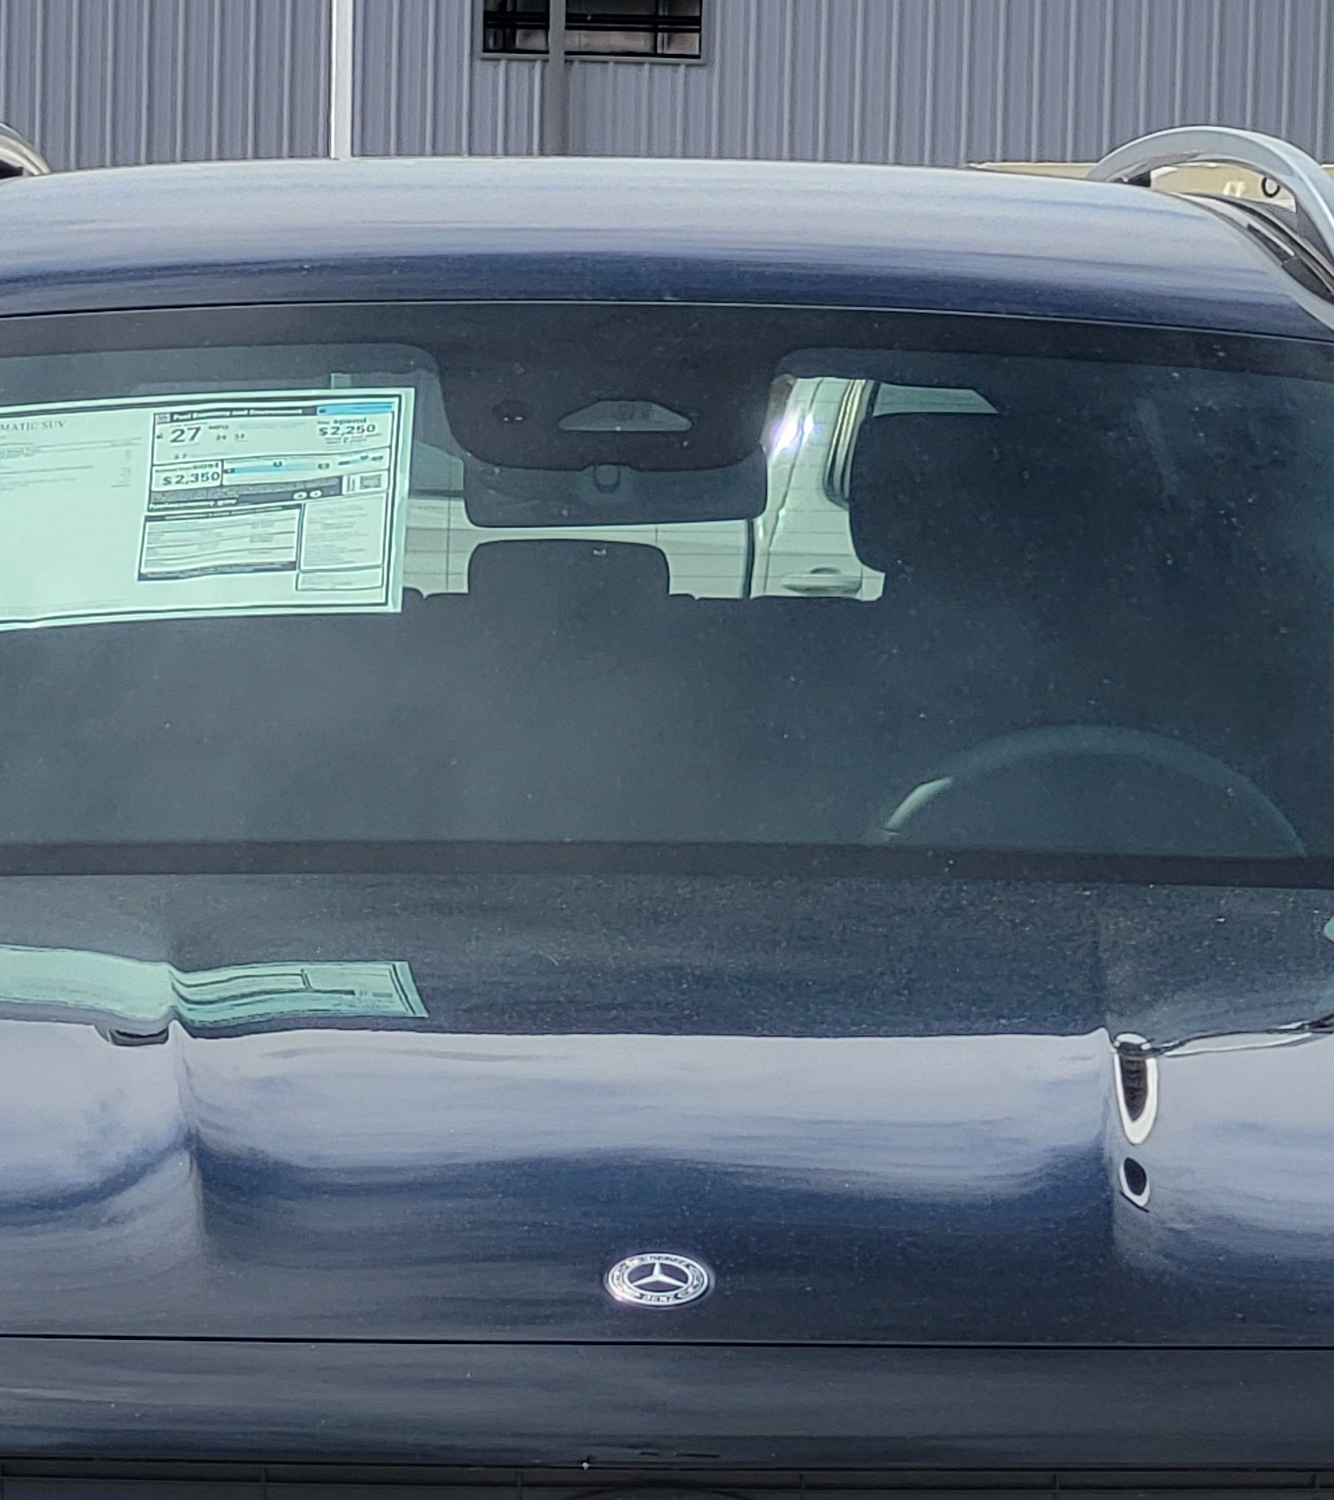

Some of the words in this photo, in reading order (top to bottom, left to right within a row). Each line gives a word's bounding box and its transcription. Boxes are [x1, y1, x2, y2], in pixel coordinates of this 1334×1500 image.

[41, 419, 67, 430] SUV
[318, 424, 376, 437] $2,250
[170, 426, 202, 443] 27
[162, 471, 220, 486] $2,350
